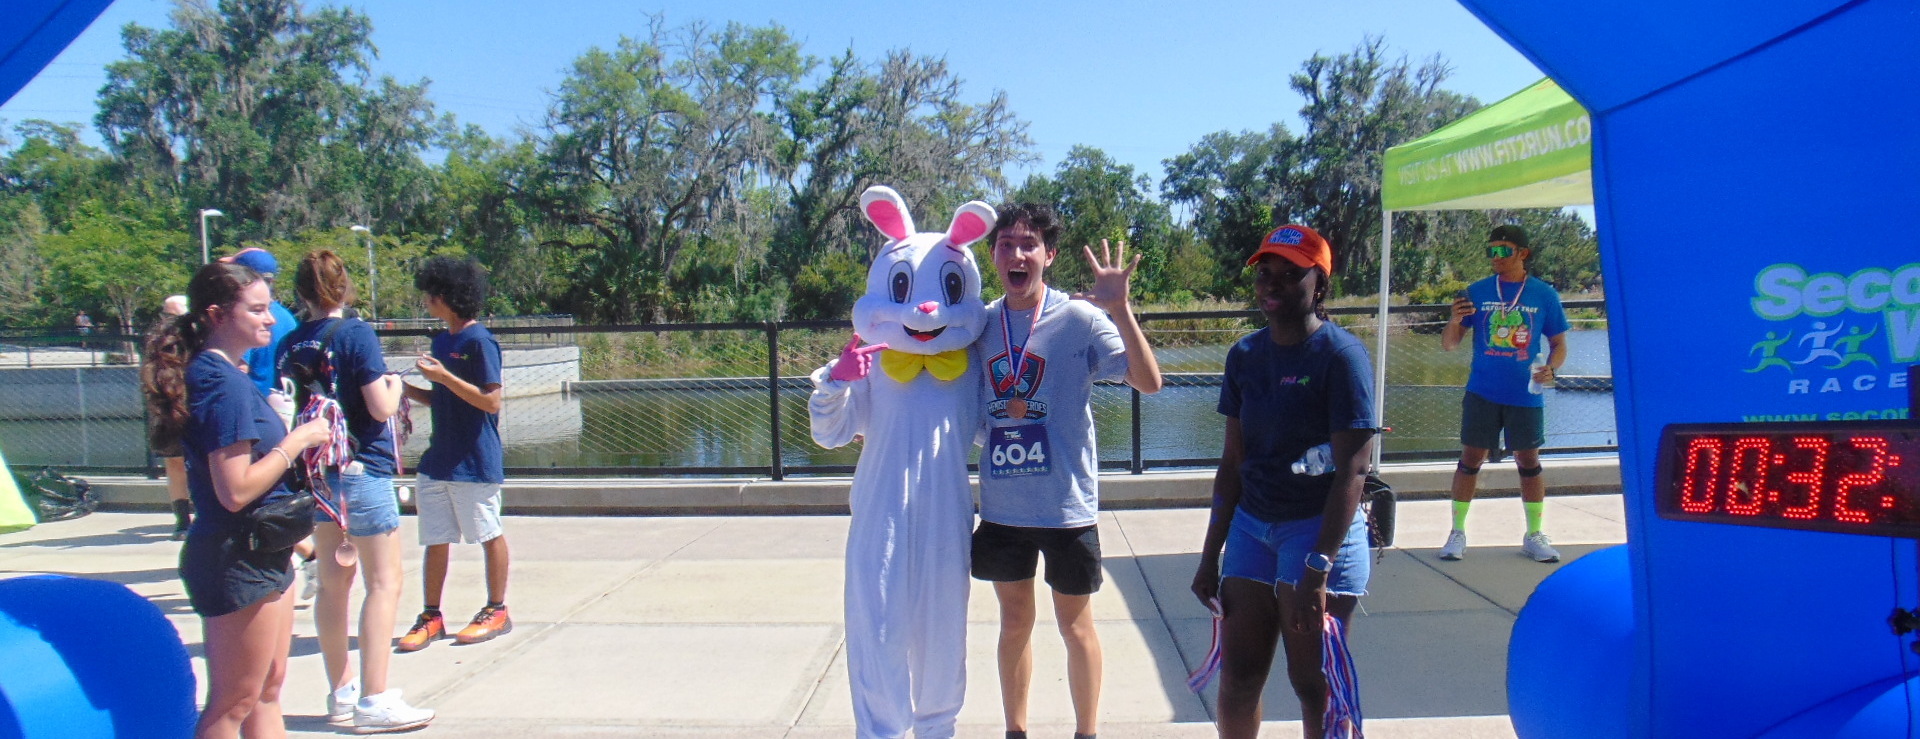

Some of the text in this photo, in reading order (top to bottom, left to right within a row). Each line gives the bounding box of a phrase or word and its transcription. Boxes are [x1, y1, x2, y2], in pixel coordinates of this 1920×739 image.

[1424, 157, 1438, 181] US
[1440, 153, 1454, 178] AT
[992, 441, 1045, 466] 604
